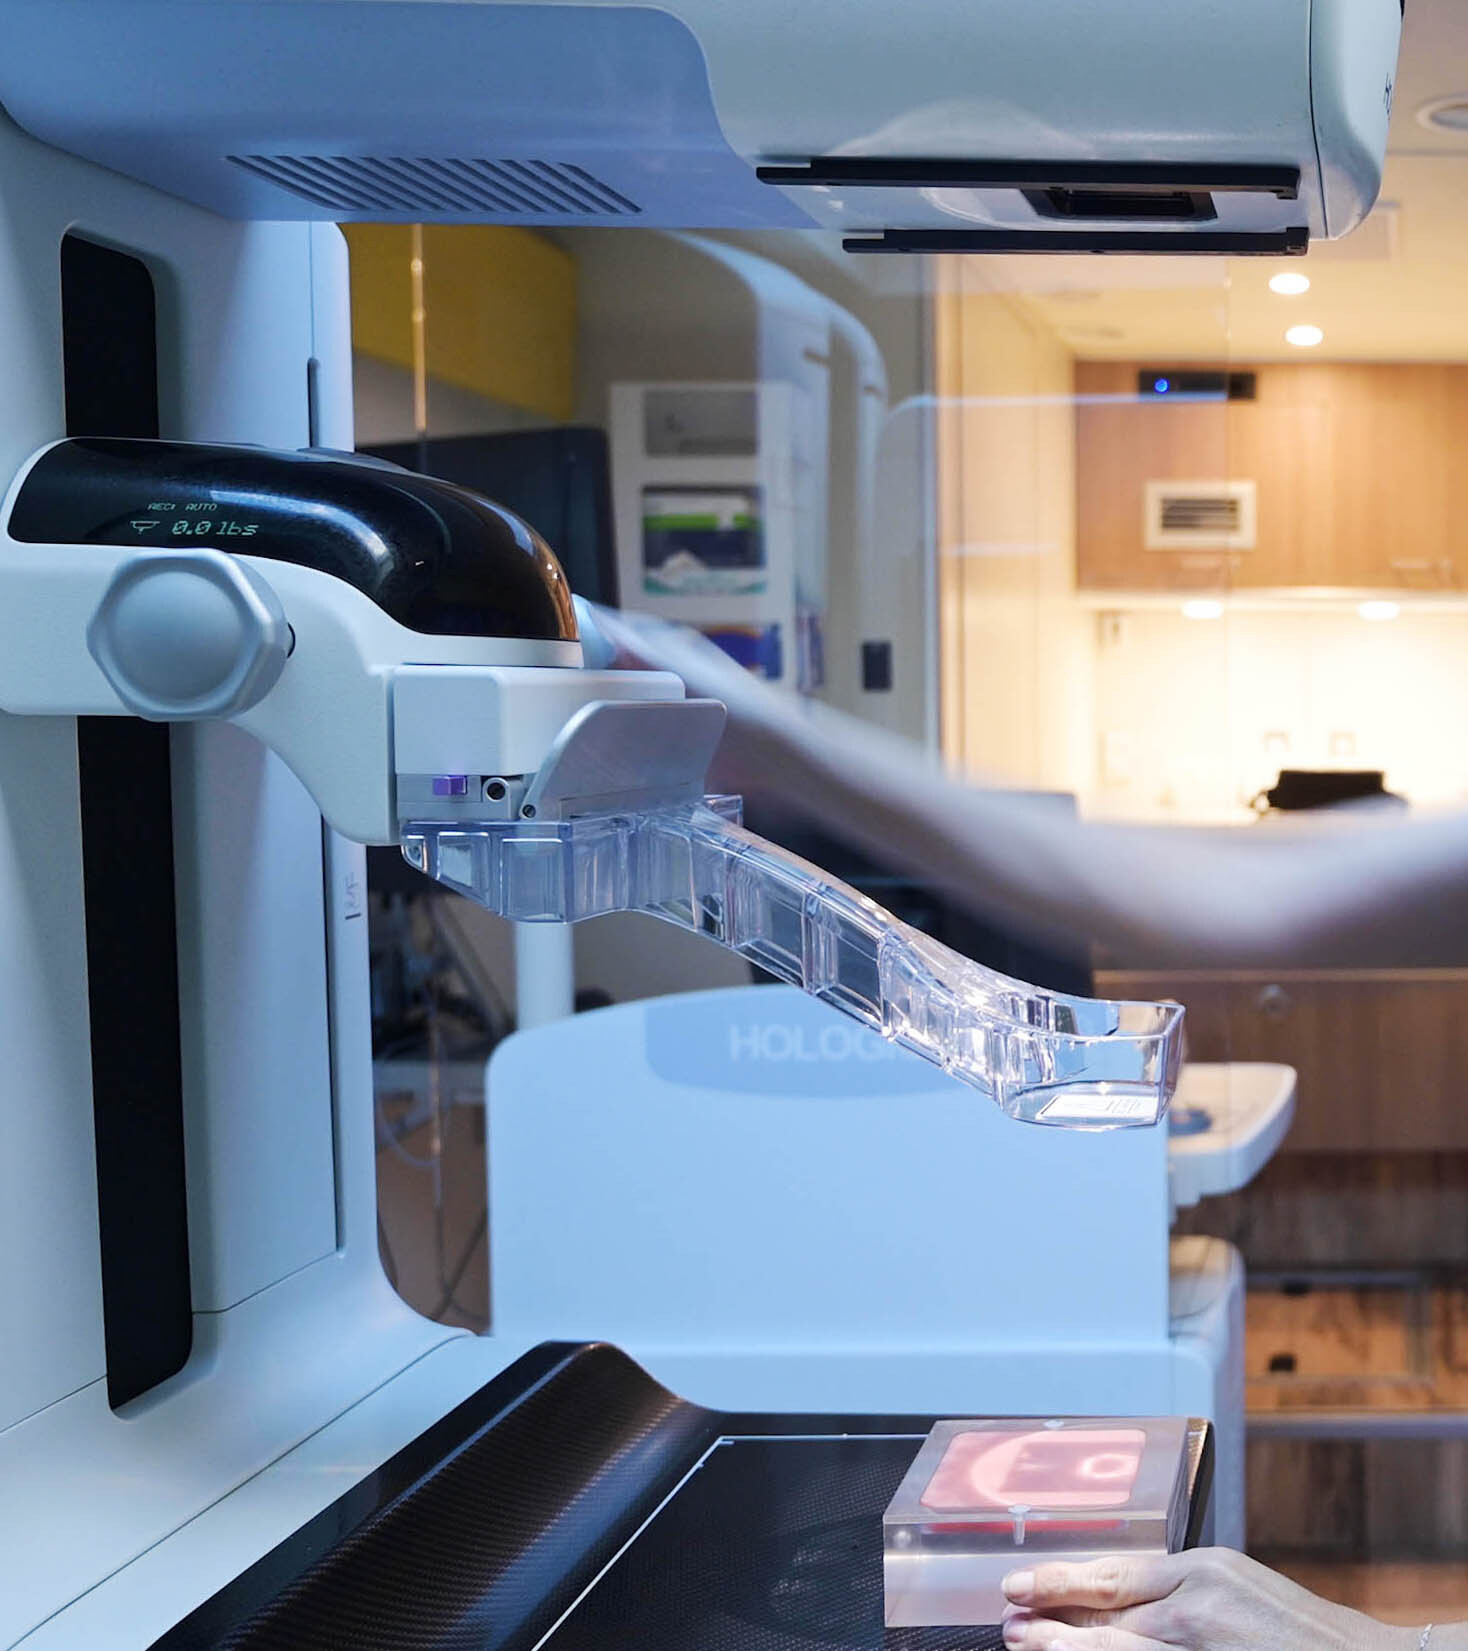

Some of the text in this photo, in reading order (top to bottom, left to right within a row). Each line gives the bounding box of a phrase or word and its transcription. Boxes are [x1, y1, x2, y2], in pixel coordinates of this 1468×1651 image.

[185, 502, 218, 512] AUTO
[171, 520, 259, 536] 0.0 lbs
